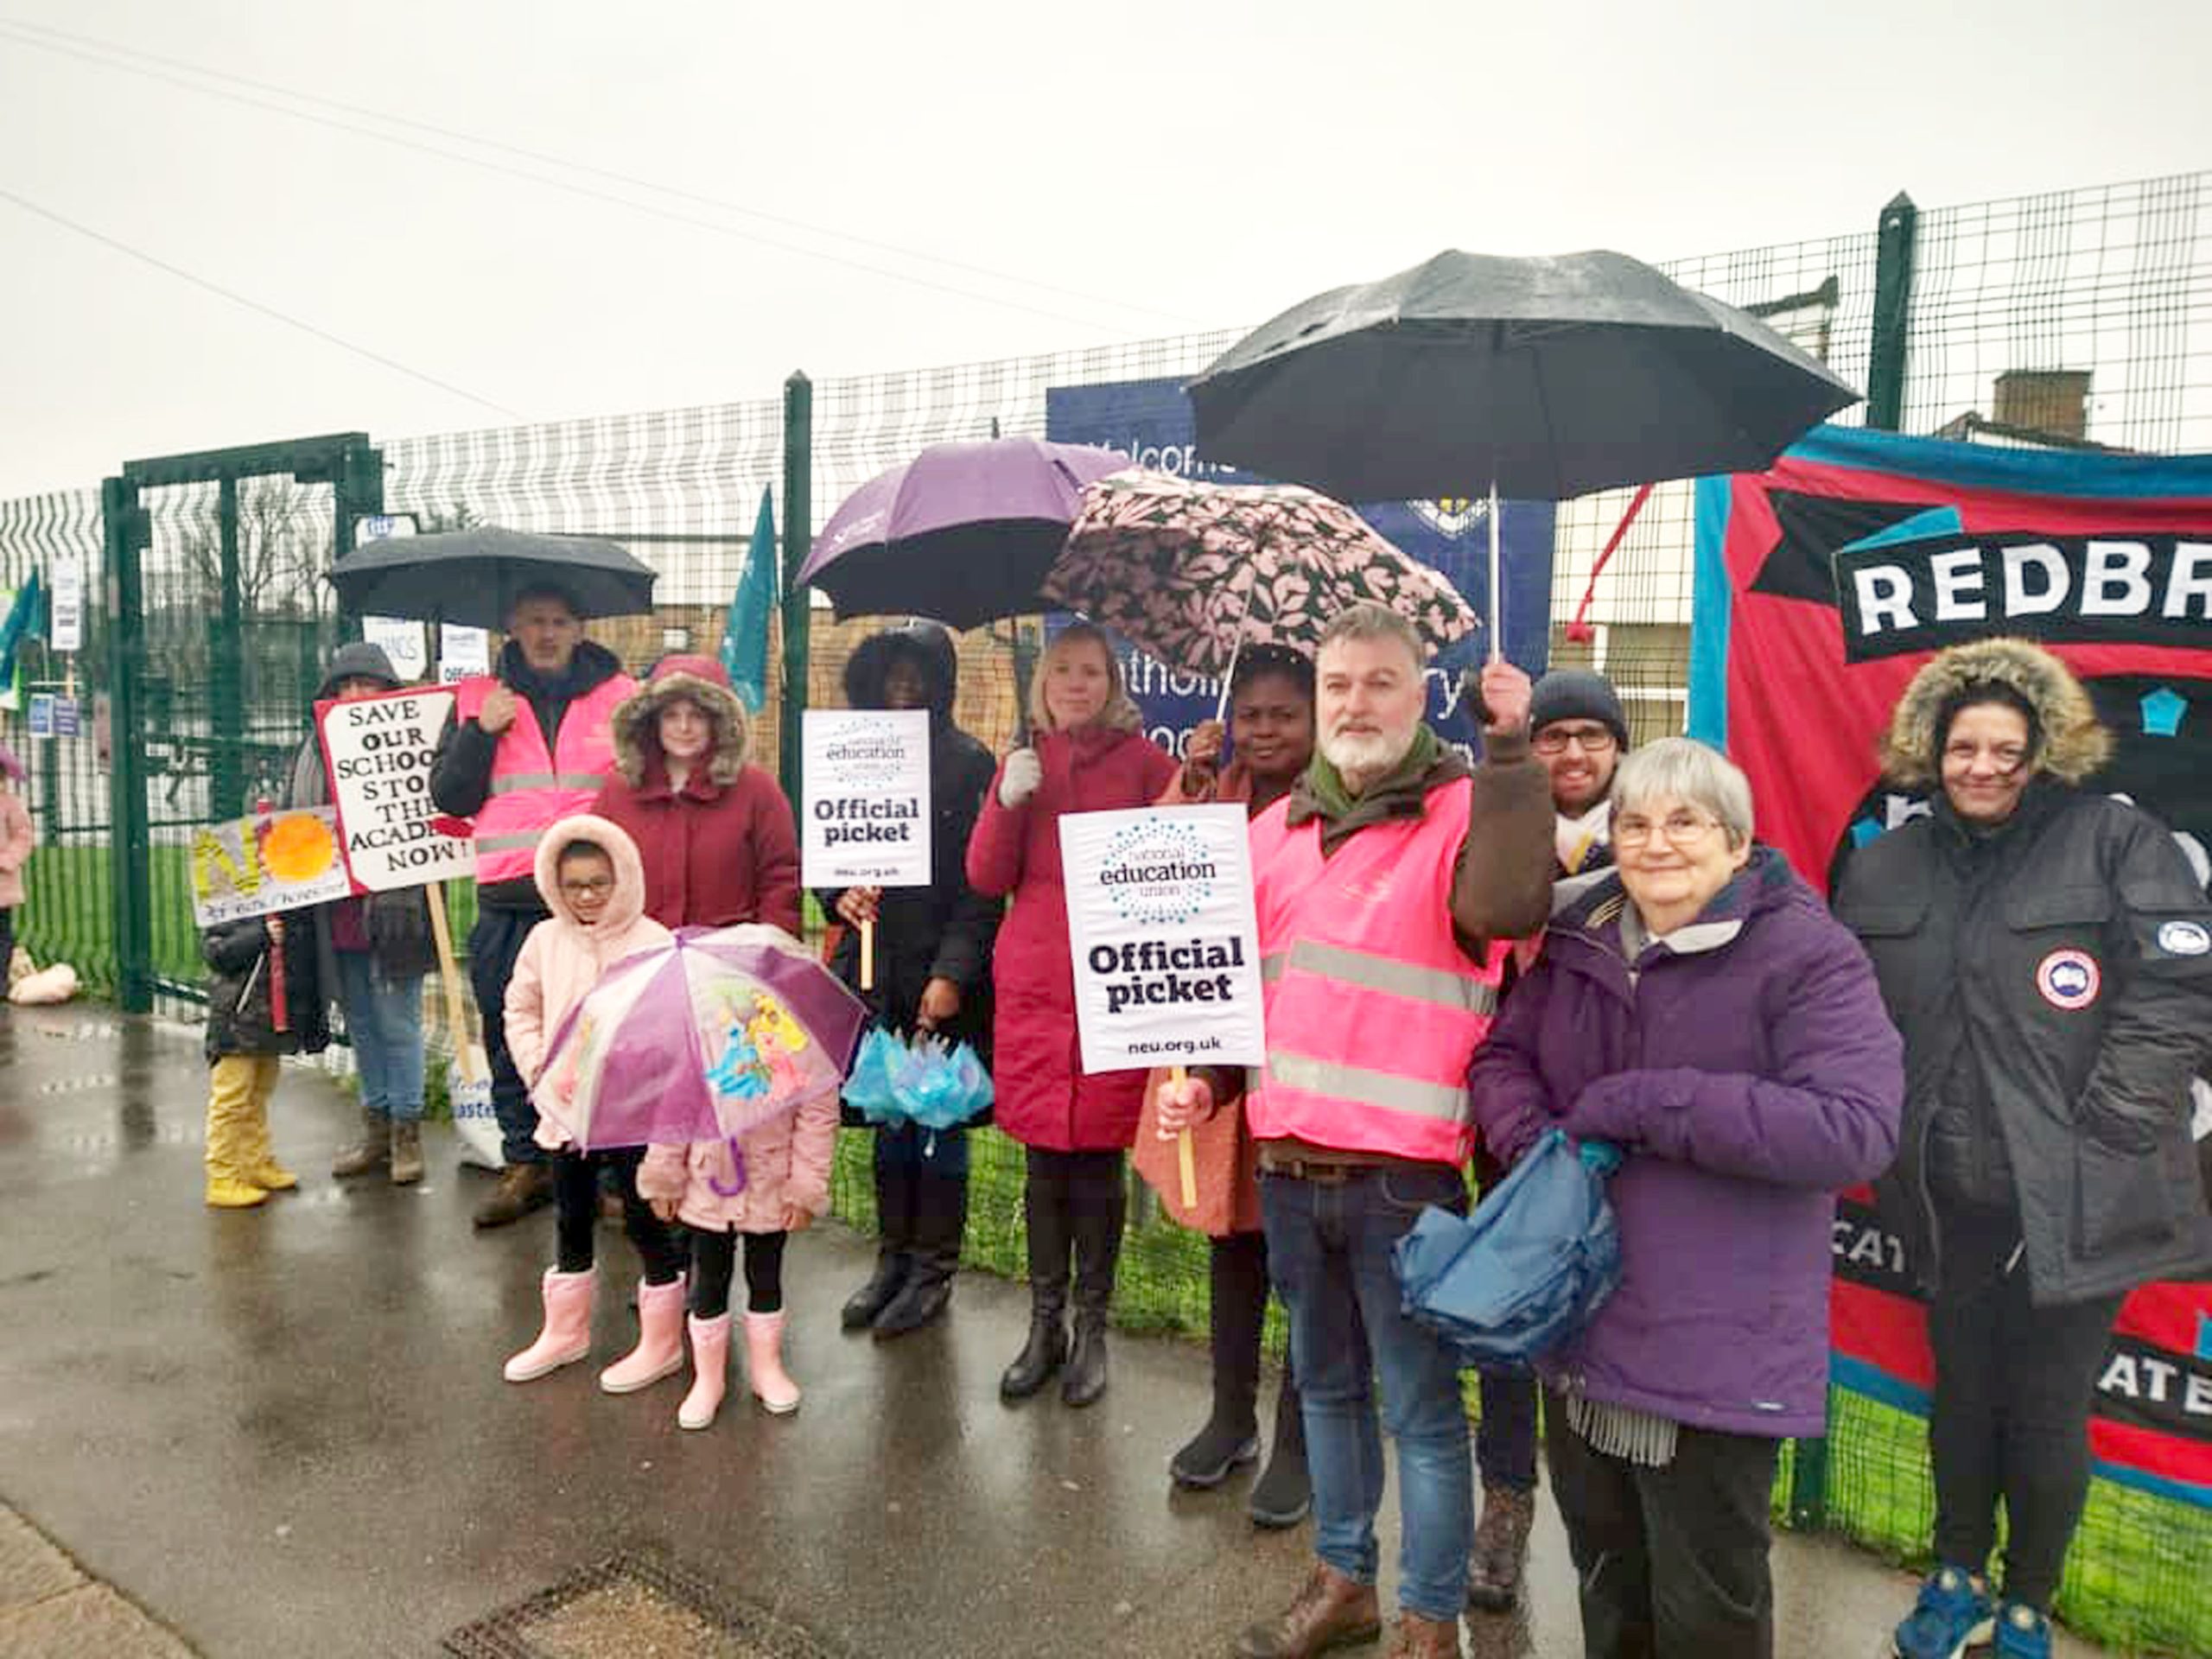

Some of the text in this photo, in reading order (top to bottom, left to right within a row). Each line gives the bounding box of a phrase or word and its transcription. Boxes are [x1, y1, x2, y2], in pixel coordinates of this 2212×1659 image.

[349, 700, 421, 727] SAVE
[362, 728, 426, 751] OUR
[827, 744, 905, 760] education
[337, 749, 439, 779] SCHOO
[363, 775, 424, 800] STO
[815, 798, 919, 820] Official
[825, 822, 911, 847] picket
[387, 841, 468, 871] NOW!
[1128, 846, 1185, 861] national
[1100, 861, 1217, 886] education
[1140, 885, 1180, 897] union
[1089, 936, 1244, 974] Official
[1107, 974, 1232, 1014] picket
[1128, 1036, 1222, 1055] neu.org.uk
